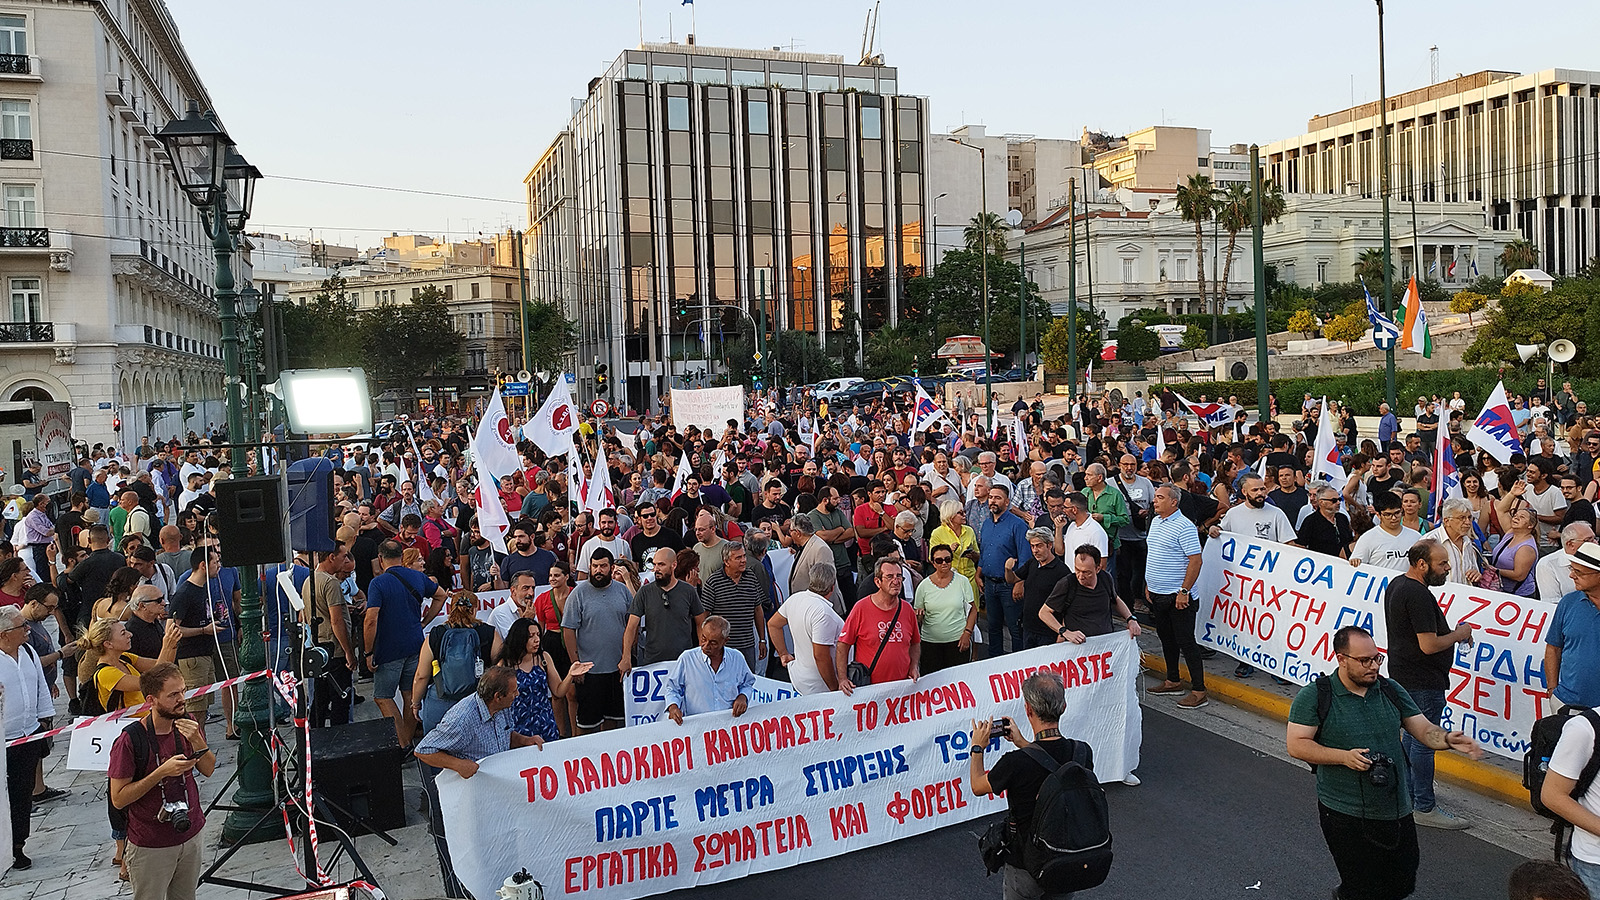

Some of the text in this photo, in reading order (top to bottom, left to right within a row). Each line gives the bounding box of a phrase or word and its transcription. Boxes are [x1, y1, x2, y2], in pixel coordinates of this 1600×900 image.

[1210, 595, 1276, 642] ΜΟΝΟ
[1286, 622, 1306, 652] Ο
[1219, 570, 1548, 689] ΣΤΑΧΤΗ ΓΙΑ ΕΡΔΗ
[1222, 537, 1280, 574] ΔΕΝ
[1293, 557, 1334, 590] ΘΑ
[1458, 596, 1548, 644] ΖΩΗ
[519, 766, 558, 803] ΤΟ
[564, 735, 694, 796] ΚΑΛΟΚΑΙΡΙ
[704, 708, 843, 766] ΚΑΙΓΟΜΑΣΤΕ,
[853, 700, 878, 732] ΤΟ
[884, 680, 976, 726] ΧΕΙΜΩΝΑ
[1202, 622, 1278, 670] Συνδικάτο
[1462, 713, 1531, 752] Ποτών
[91, 737, 102, 754] 5
[595, 730, 1001, 843] ΠΑΡΤΕ ΜΕΤΡΑ ΣΤΗΡΙΞΗΣ ΤΩΑ
[564, 842, 678, 894] ΕΡΓΑΤΙΚΑ
[694, 814, 813, 872] ΣΩΜΑΤΕΙΑ
[830, 802, 869, 841] ΚΑΙ
[886, 777, 968, 825] ΦΟΡΕΙΣ
